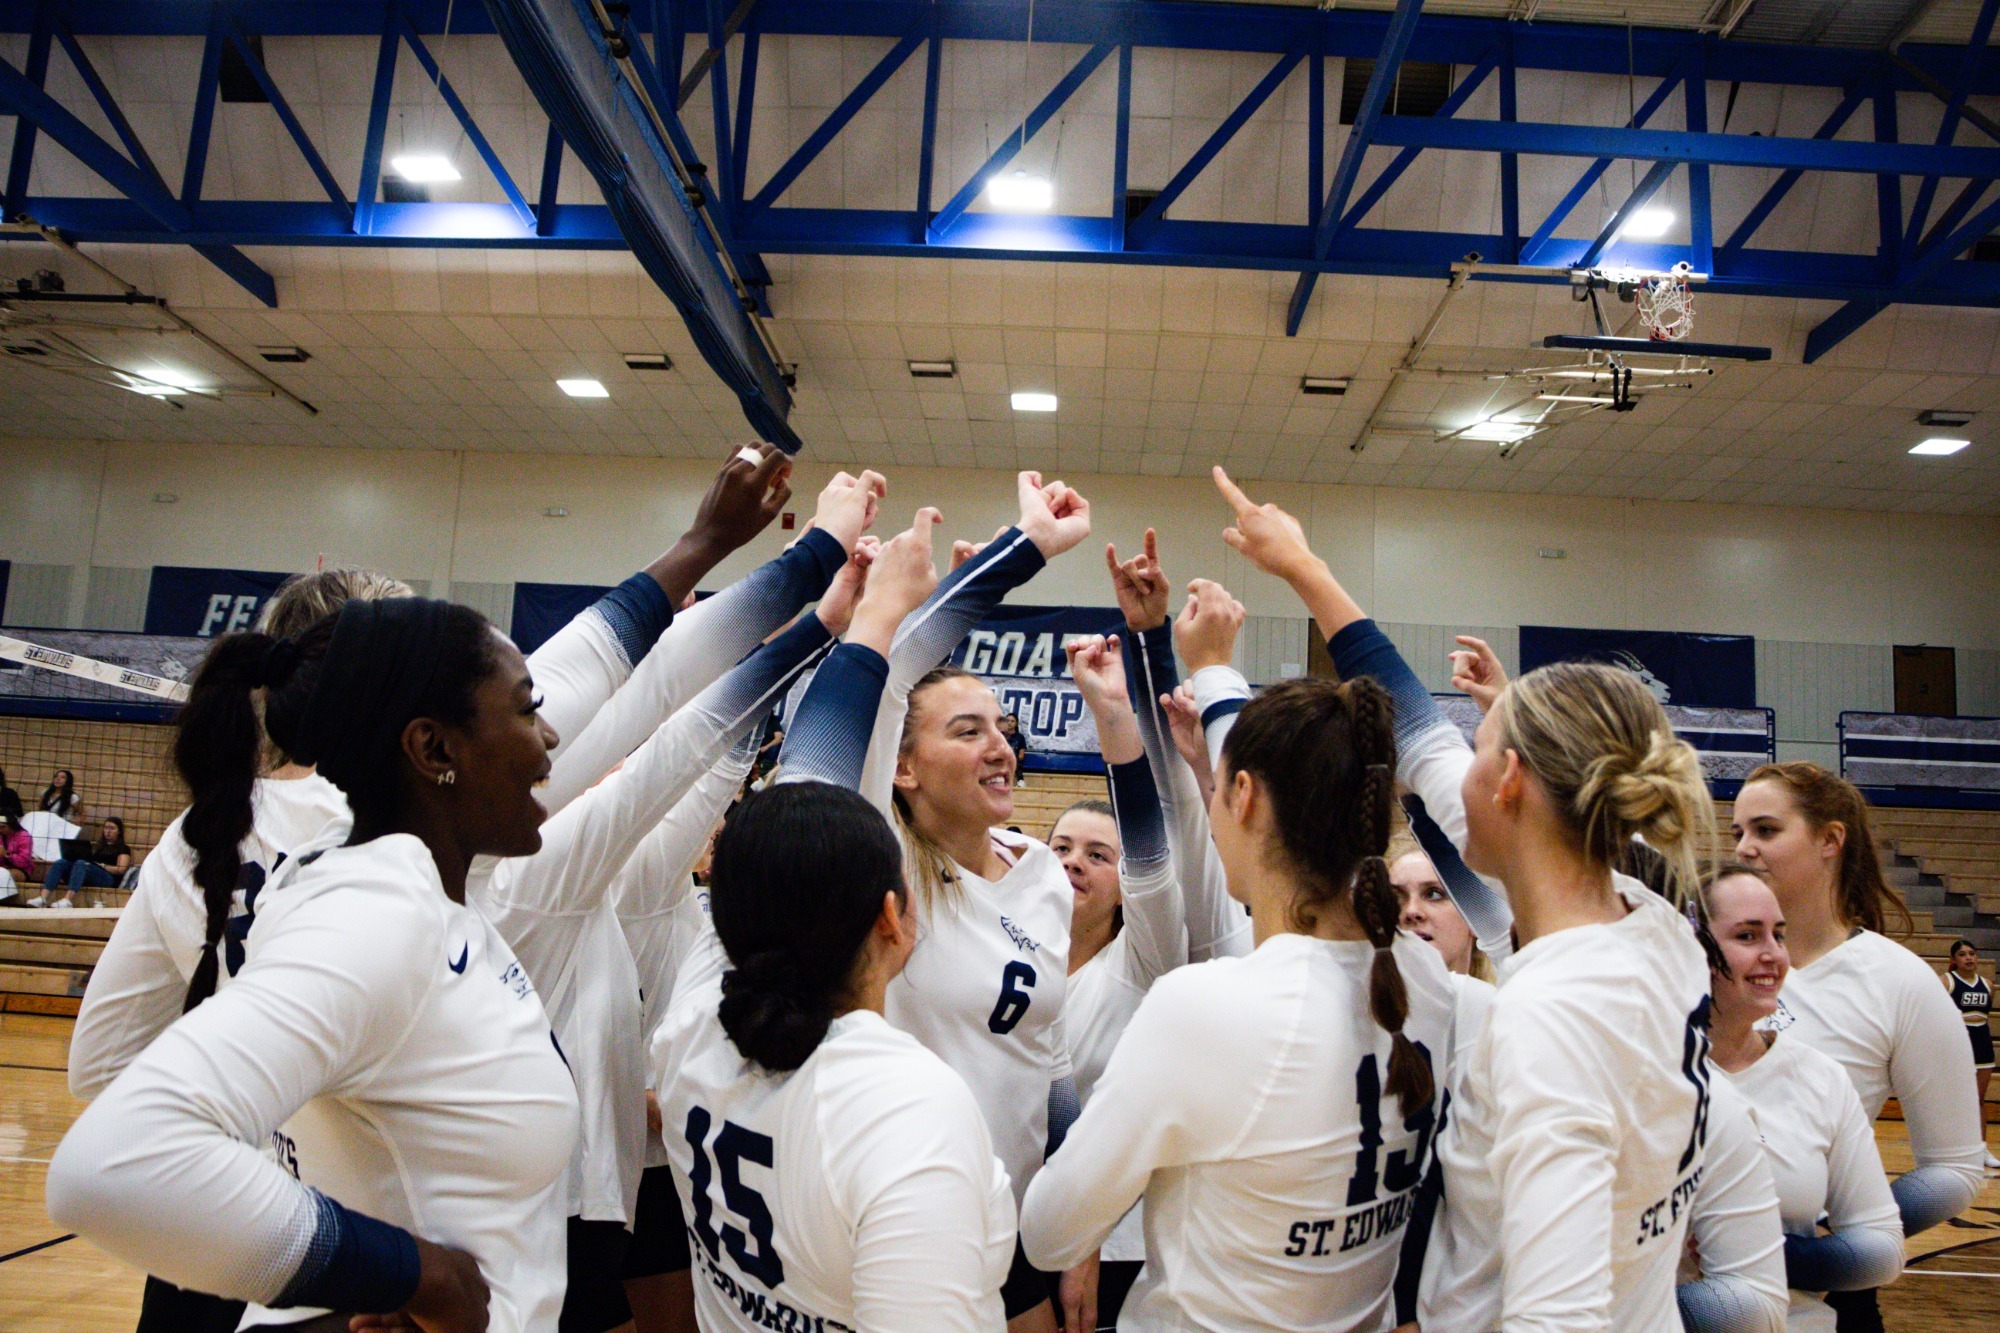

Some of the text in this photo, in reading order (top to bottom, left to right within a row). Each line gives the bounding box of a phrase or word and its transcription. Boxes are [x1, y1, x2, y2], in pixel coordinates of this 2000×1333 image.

[988, 960, 1036, 1034] 6
[1961, 992, 1988, 1006] SEU
[685, 1105, 784, 1291] 15
[1284, 1219, 1335, 1256] ST.
